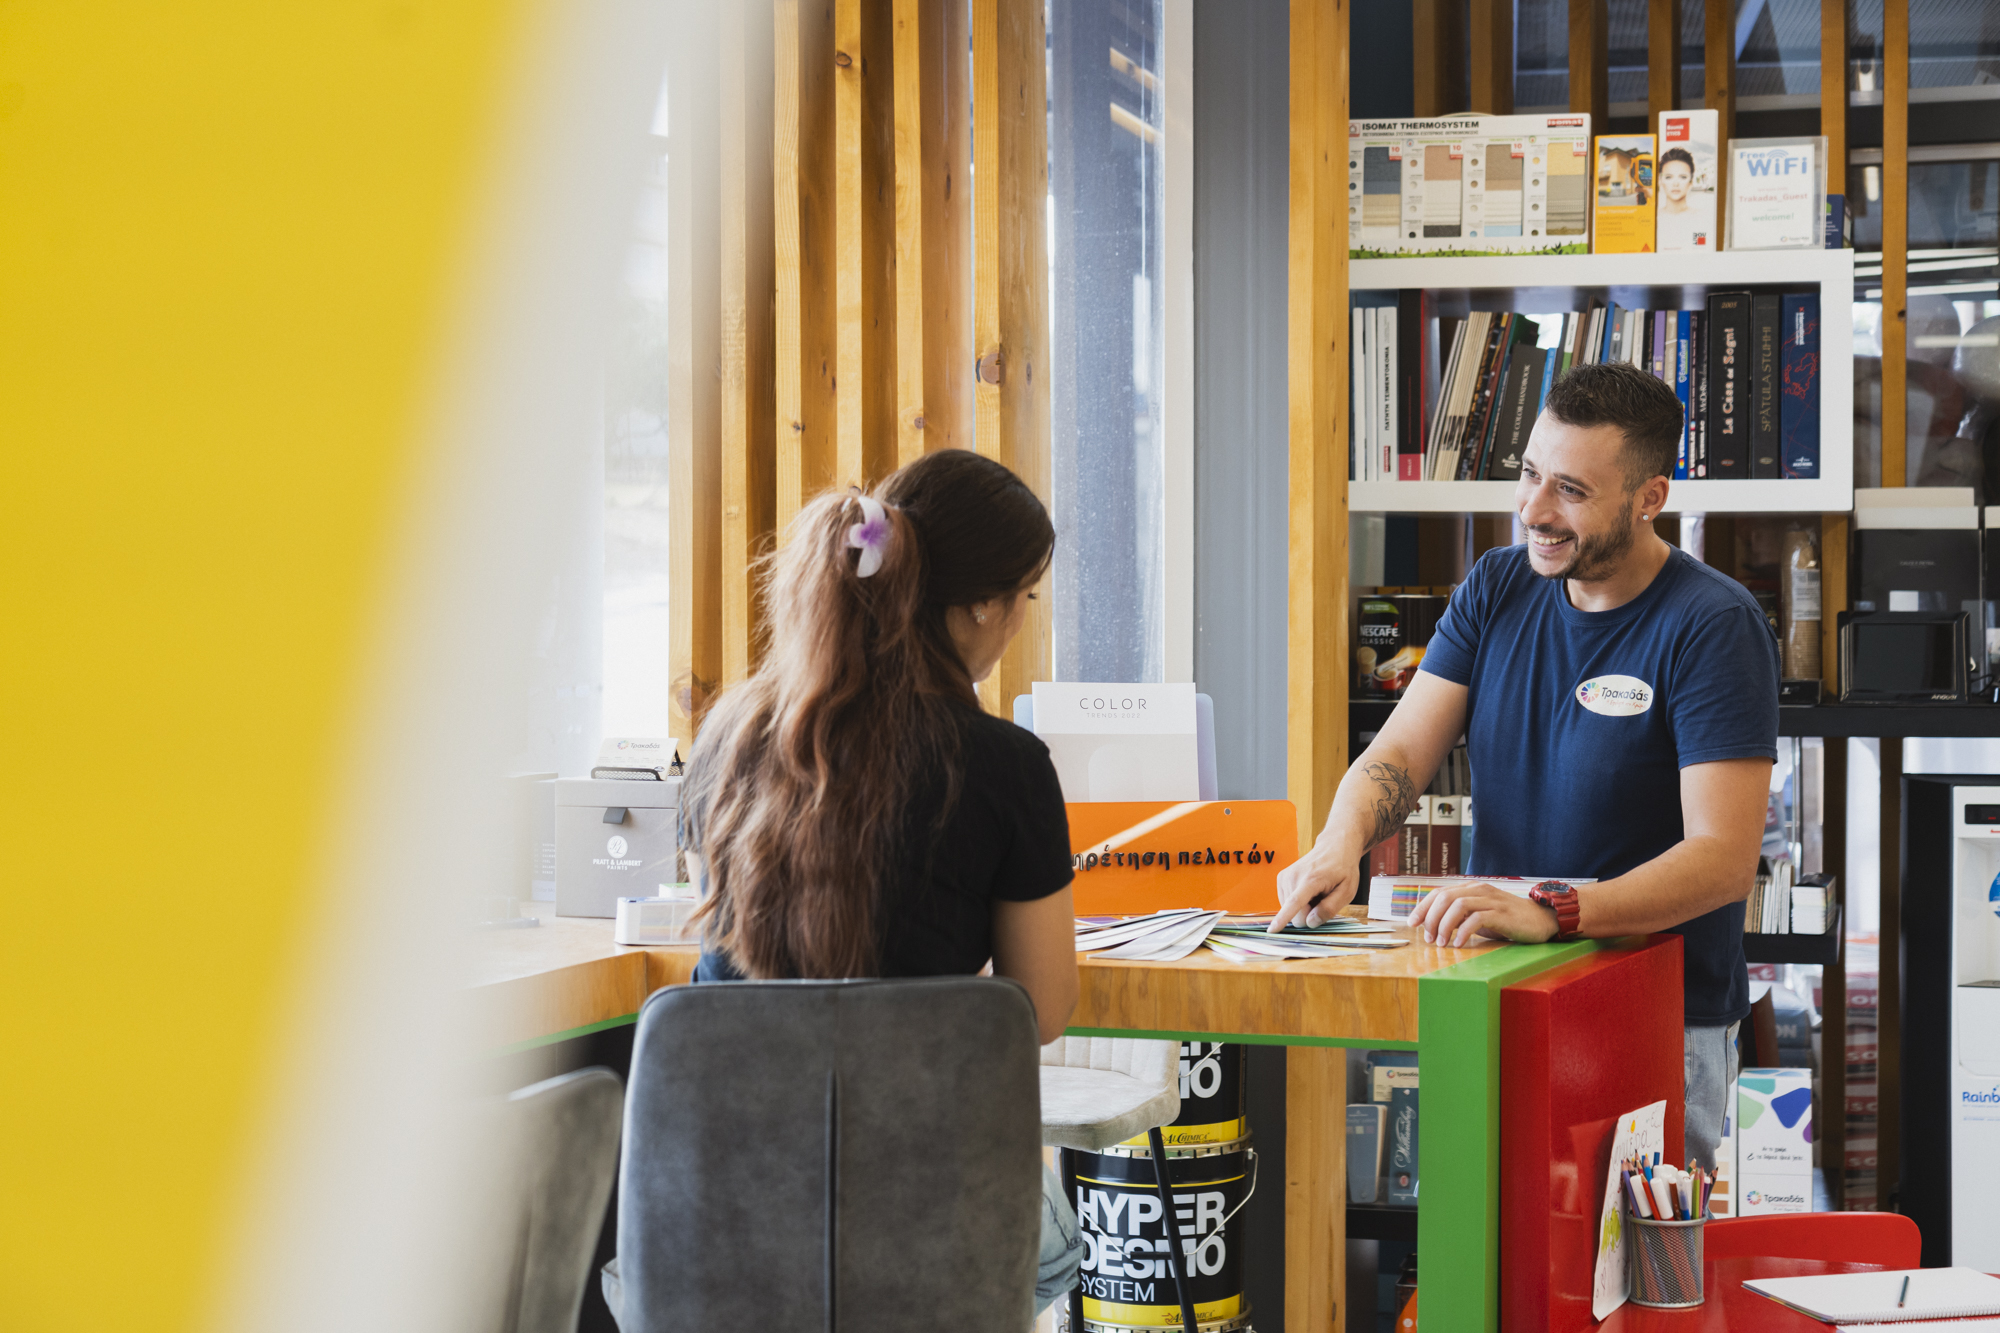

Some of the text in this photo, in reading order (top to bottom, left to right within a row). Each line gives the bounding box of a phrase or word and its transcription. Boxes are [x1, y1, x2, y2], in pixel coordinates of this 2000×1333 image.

[1362, 121, 1479, 131] ISOMAT THERMOSYSTEM
[1740, 151, 1766, 160] Free
[1747, 157, 1807, 176] WiFi
[1739, 193, 1808, 203] Trakadas_Guest
[1752, 213, 1794, 222] welcome!
[1723, 327, 1737, 365] Sogni
[1511, 364, 1531, 445] THE COLOR HANDBOOK
[1722, 381, 1734, 414] Casa
[1722, 417, 1734, 435] La
[1360, 622, 1399, 637] NESCAFÉ
[1361, 637, 1395, 645] CLASSIC
[1079, 697, 1147, 710] COLOR
[1178, 842, 1275, 865] πελατών
[1441, 842, 1449, 869] CONCEPT
[616, 859, 641, 867] LAMBERT
[1077, 1185, 1226, 1236] HYPER
[1080, 1231, 1226, 1279] DESMO
